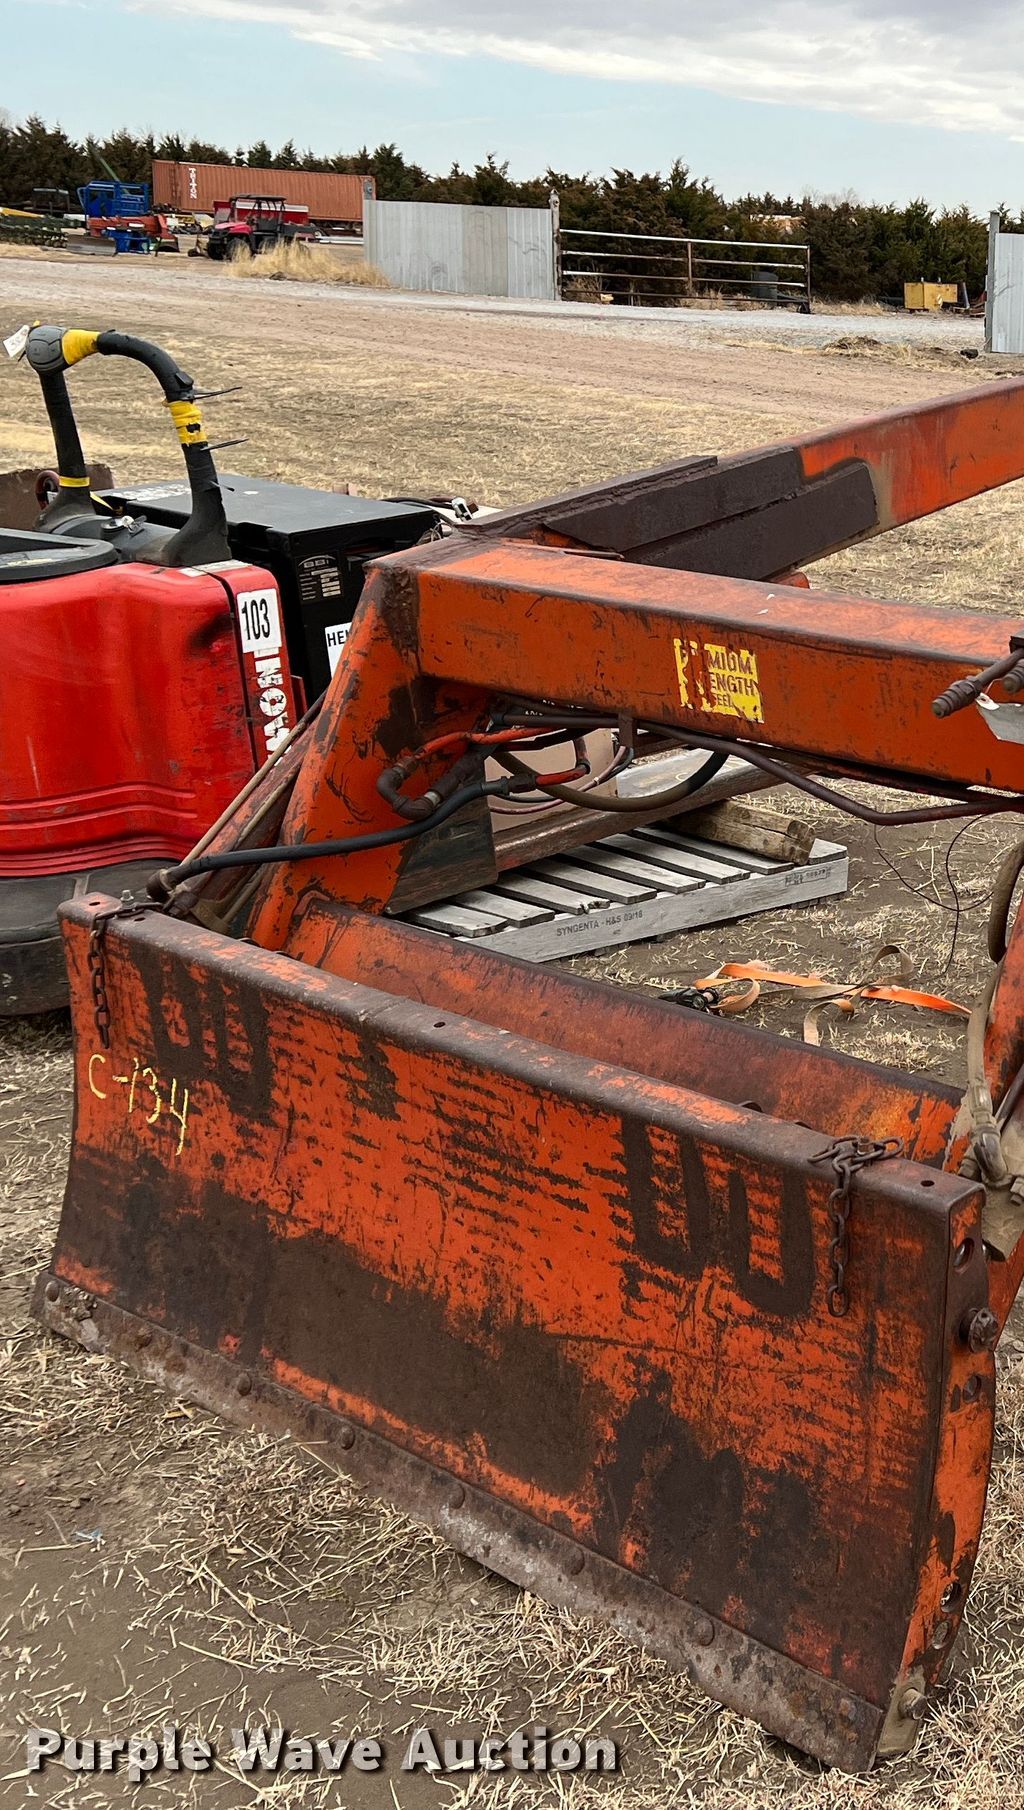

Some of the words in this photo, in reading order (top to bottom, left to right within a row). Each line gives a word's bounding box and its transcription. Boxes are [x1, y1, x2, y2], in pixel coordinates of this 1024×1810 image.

[188, 167, 198, 199] TRITON
[241, 598, 271, 641] 103
[556, 920, 599, 937] SYNGENTA
